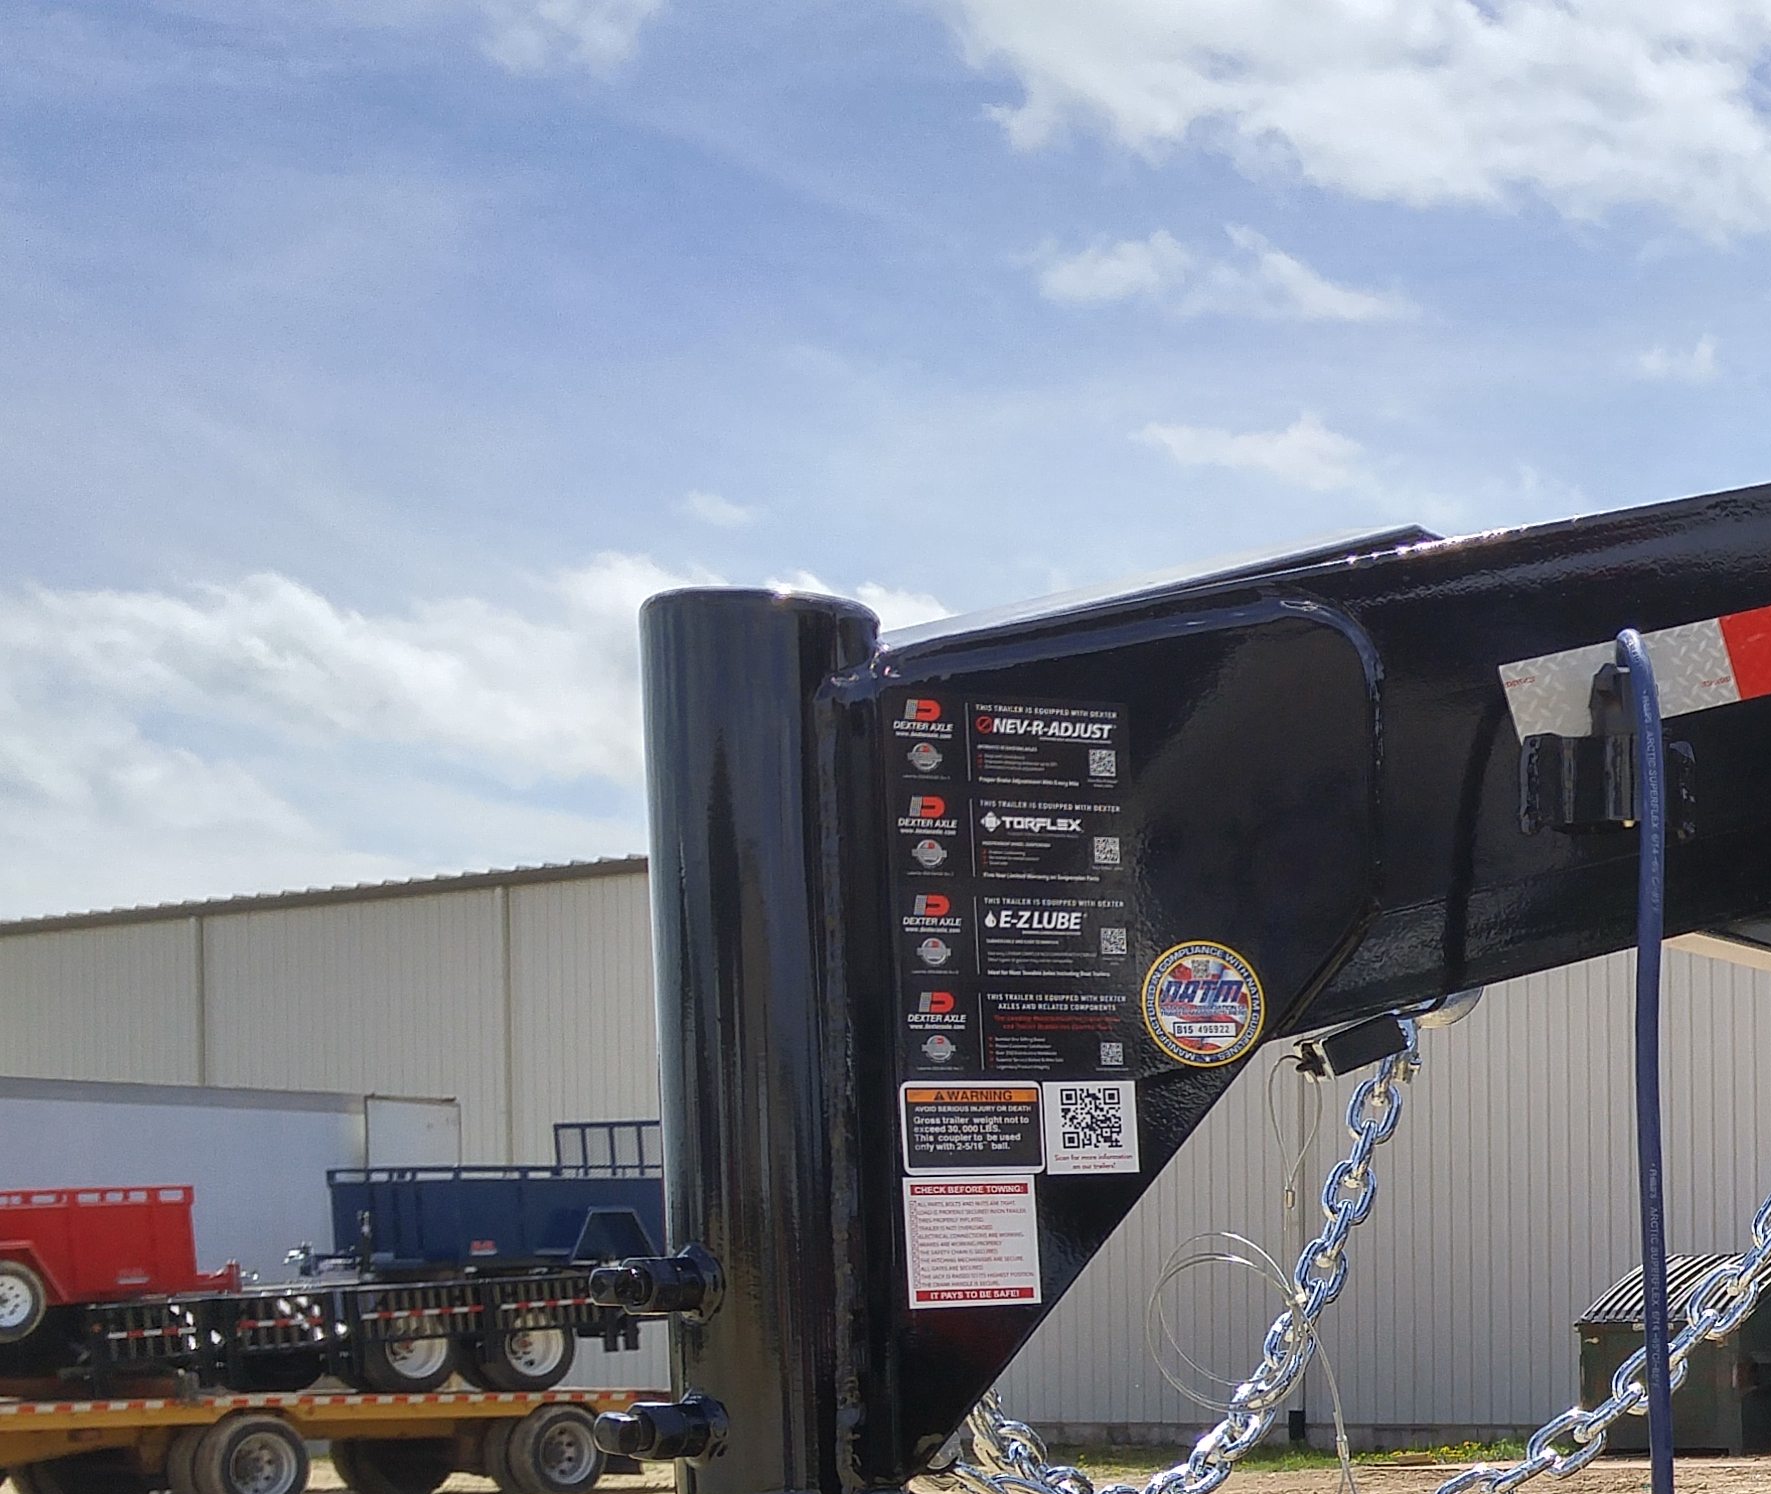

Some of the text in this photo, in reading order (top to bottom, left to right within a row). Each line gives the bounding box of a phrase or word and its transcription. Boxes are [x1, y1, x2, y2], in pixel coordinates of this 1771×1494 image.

[893, 720, 954, 732] DEXTER AXLE
[992, 717, 1114, 739] NEV-R-ADJUST
[1646, 731, 1656, 767] ARCTIC
[1648, 769, 1658, 828] SUPERFLEX
[980, 799, 1121, 813] THIS TRAILER IS EQUIPPED WITH DEXTER
[898, 817, 958, 829] DEXTER AXLE
[1001, 816, 1082, 833] TORFLEX
[984, 897, 1001, 905] THIS
[1033, 898, 1041, 906] IS
[1041, 899, 1077, 907] EQUIPPED
[1097, 900, 1124, 908] DEXTER
[902, 916, 962, 927] DEXTER AXLE
[999, 910, 1082, 930] E-Z LUBE
[1159, 945, 1224, 972] COMPLIANCE
[1225, 953, 1249, 978] WITH
[1151, 972, 1161, 985] IN
[987, 993, 1003, 1001] THIS
[1044, 994, 1079, 1002] EQUIPPED
[1247, 977, 1260, 1010] NATM
[998, 1003, 1020, 1011] AXLES
[1021, 1003, 1037, 1011] AND
[1037, 1003, 1069, 1011] RELATED
[907, 1013, 967, 1023] DEXTER AXLE
[1147, 986, 1196, 1061] MANUFACTURED
[1217, 1014, 1260, 1061] GUIDELINES
[947, 1090, 1013, 1101] WARNING
[913, 1116, 1029, 1126] Gross trailer weight not to
[913, 1124, 946, 1133] exceed
[979, 1124, 1001, 1133] LBS.
[914, 1133, 934, 1142] This
[937, 1133, 972, 1143] coupler
[986, 1133, 998, 1141] be
[999, 1133, 1022, 1141] used
[914, 1142, 934, 1152] only
[936, 1142, 956, 1151] with
[991, 1142, 1011, 1150] ball.
[1070, 1153, 1080, 1161] for
[914, 1185, 1024, 1194] CHECK BEFORE TOWING:
[1649, 1206, 1659, 1243] ARCTIC
[1650, 1246, 1660, 1305] SUPERFLEX
[930, 1290, 1020, 1299] IT PAYS TO BE SAFE!
